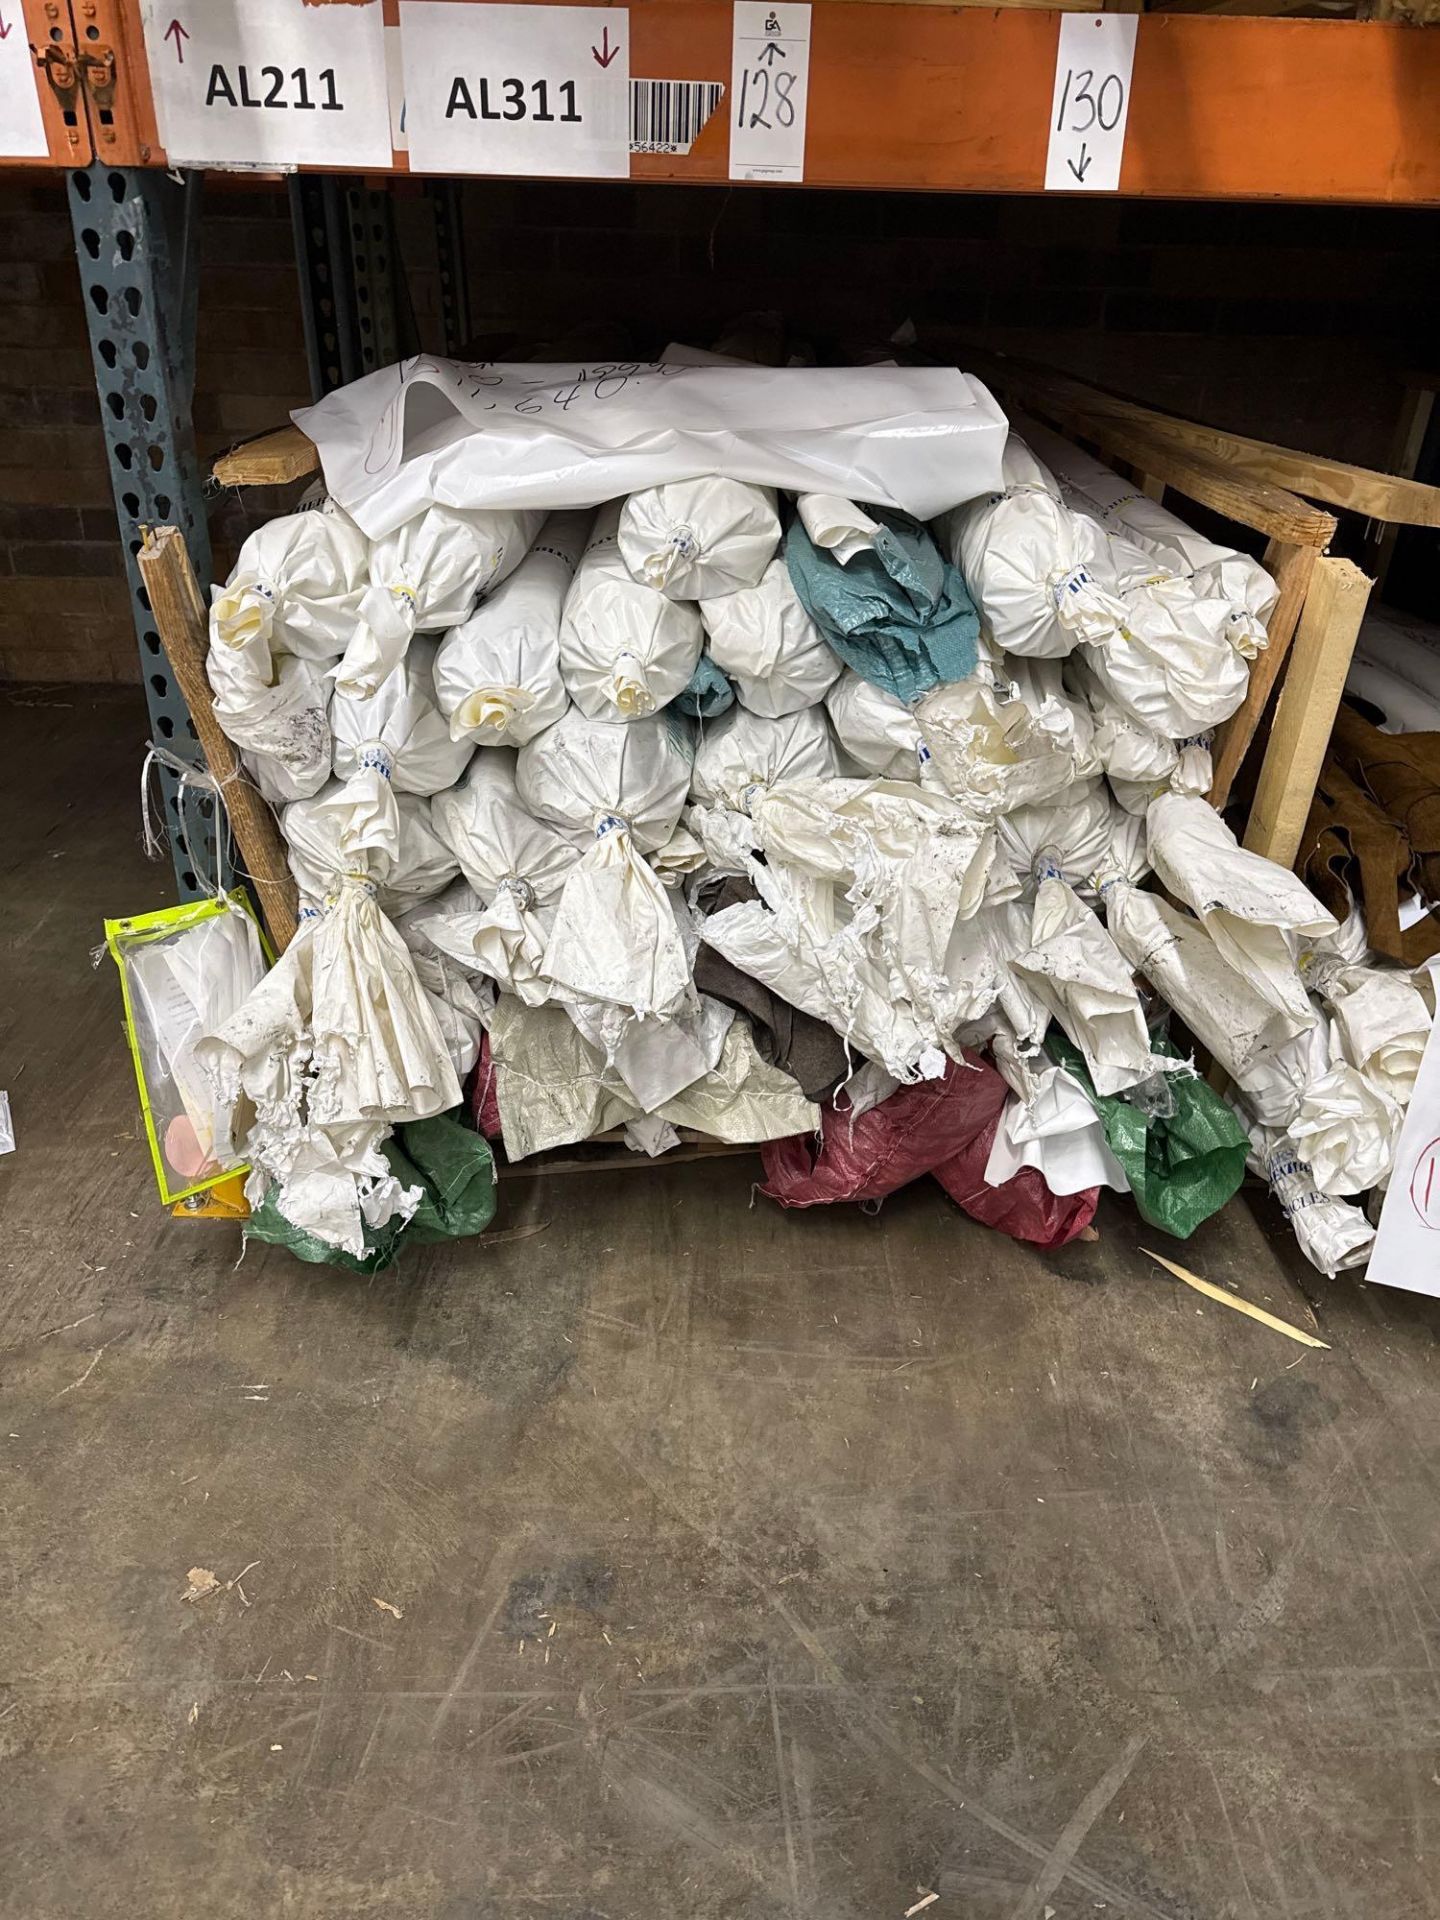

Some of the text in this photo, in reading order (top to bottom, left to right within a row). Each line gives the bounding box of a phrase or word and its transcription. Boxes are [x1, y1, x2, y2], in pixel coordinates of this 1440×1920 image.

[205, 64, 344, 111] AL211
[445, 77, 583, 123] AL311
[738, 68, 797, 130] 128
[1056, 69, 1123, 133] 130
